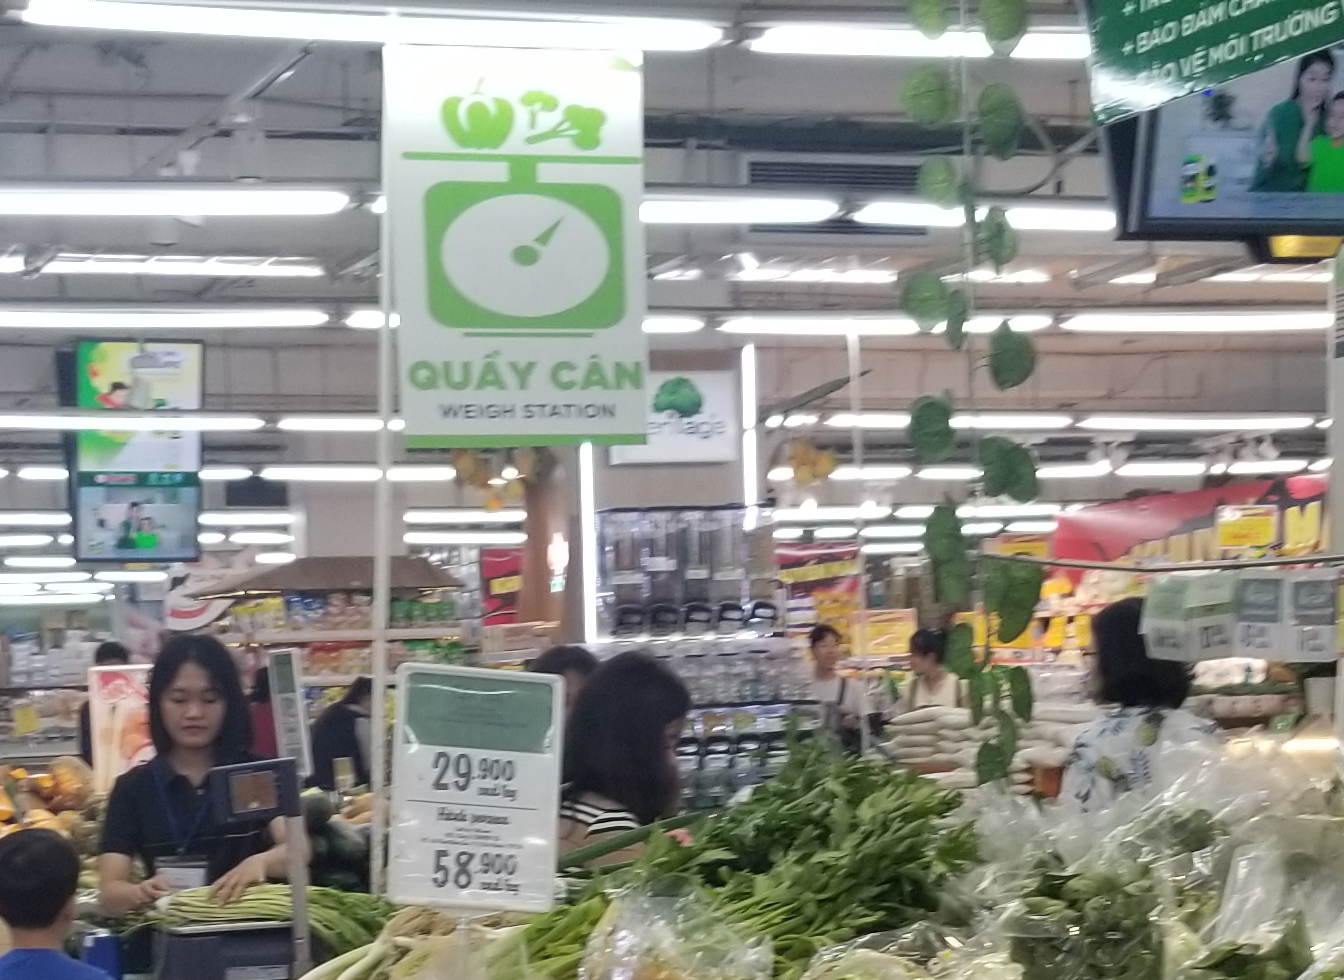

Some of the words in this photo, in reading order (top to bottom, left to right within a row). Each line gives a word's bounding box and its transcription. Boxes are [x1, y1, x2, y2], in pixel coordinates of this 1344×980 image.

[550, 354, 644, 391] CÂN
[439, 403, 516, 420] WEIGH
[522, 403, 617, 420] STATION
[432, 751, 516, 792] 29.900
[432, 849, 518, 889] 58.900
